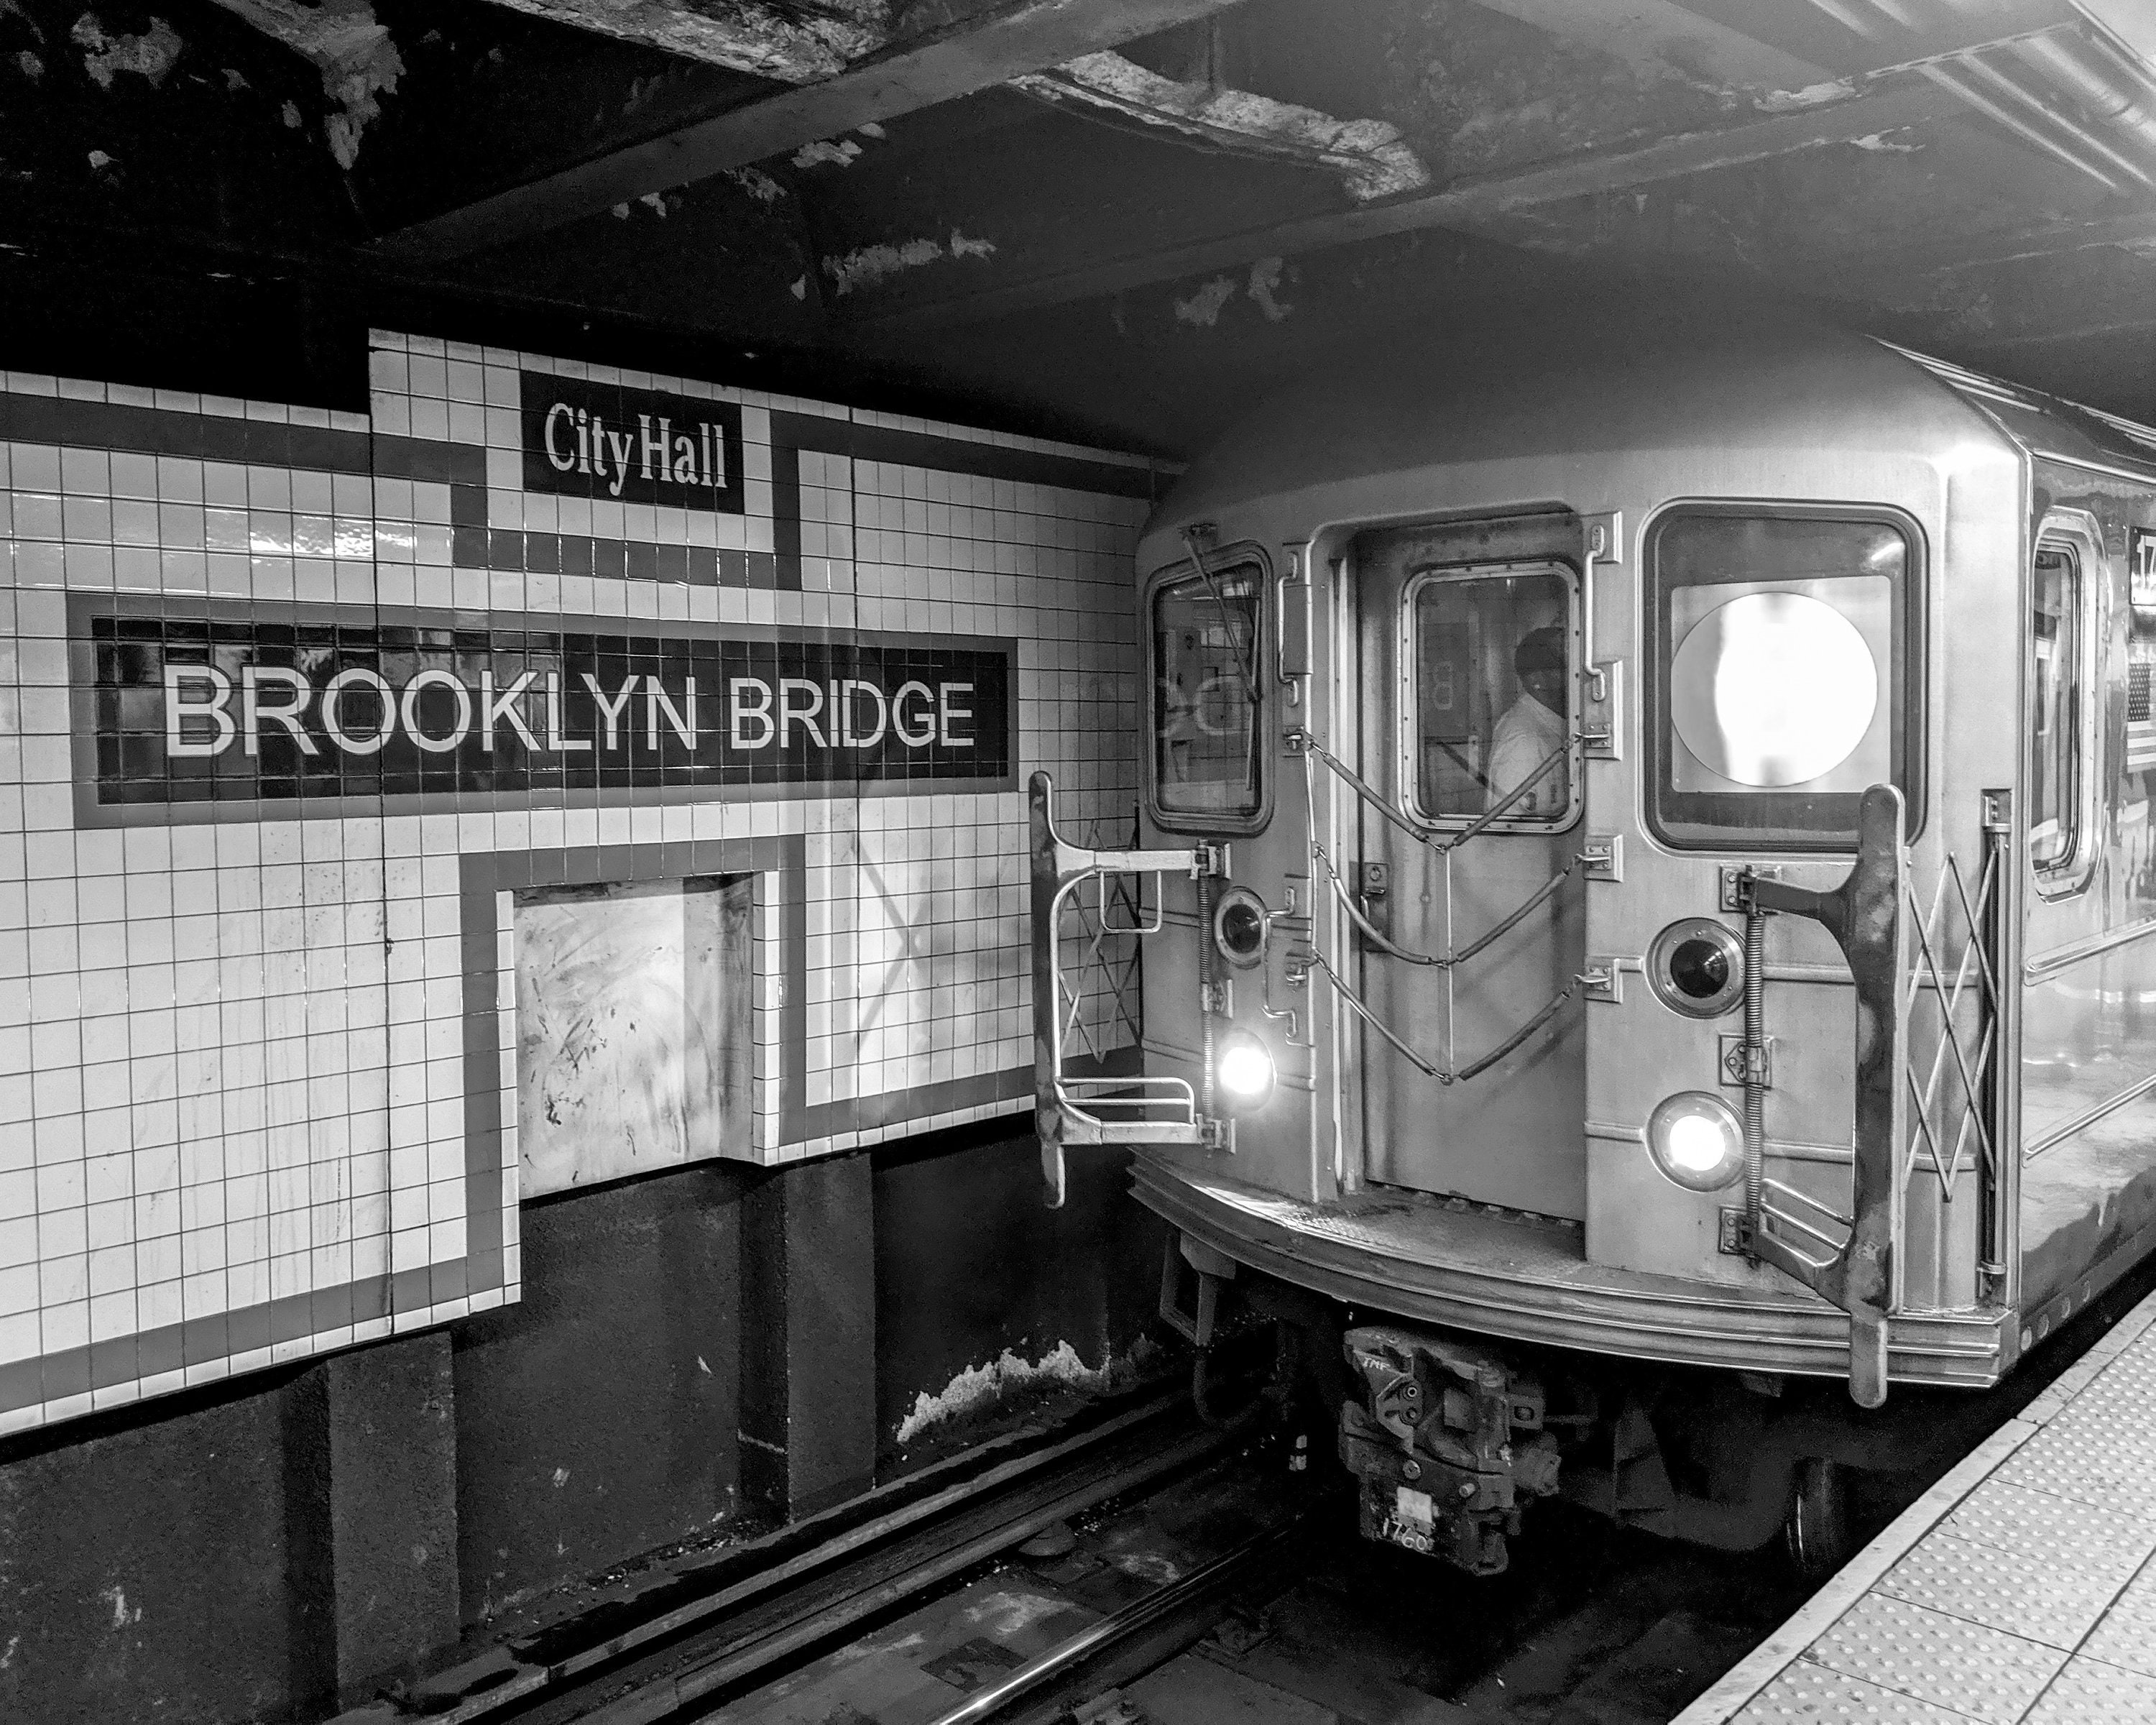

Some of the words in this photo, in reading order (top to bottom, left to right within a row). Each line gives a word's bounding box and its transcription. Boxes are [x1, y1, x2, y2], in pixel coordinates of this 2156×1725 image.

[545, 402, 633, 496] City
[638, 414, 728, 489] Hall
[164, 664, 697, 757] BROOKLYN
[729, 677, 975, 749] BRIDGE
[1383, 1518, 1427, 1550] 1760
